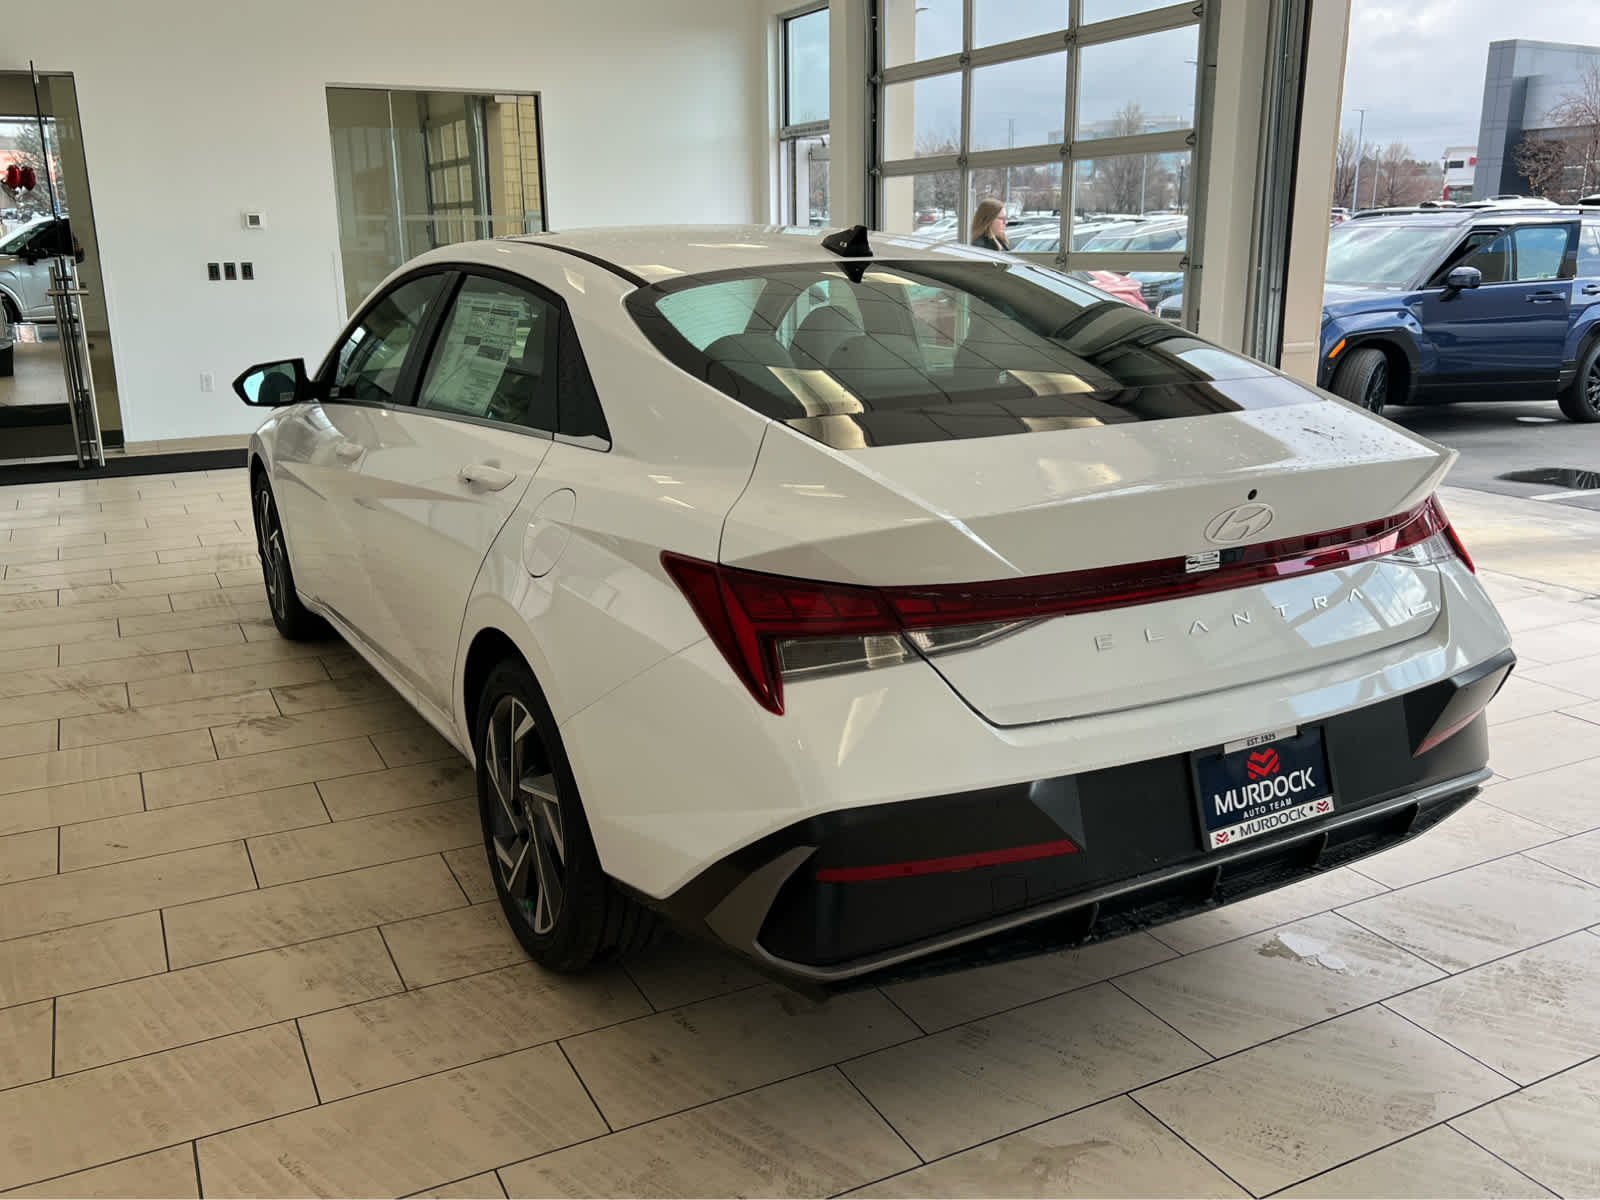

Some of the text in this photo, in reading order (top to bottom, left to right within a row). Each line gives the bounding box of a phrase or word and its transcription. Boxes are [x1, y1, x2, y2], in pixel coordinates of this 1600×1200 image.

[1094, 587, 1364, 652] ELANTRA
[1214, 767, 1316, 816] MURDOCK
[1243, 798, 1292, 819] AUTO TEAM
[1239, 806, 1306, 837] MURDOCK
